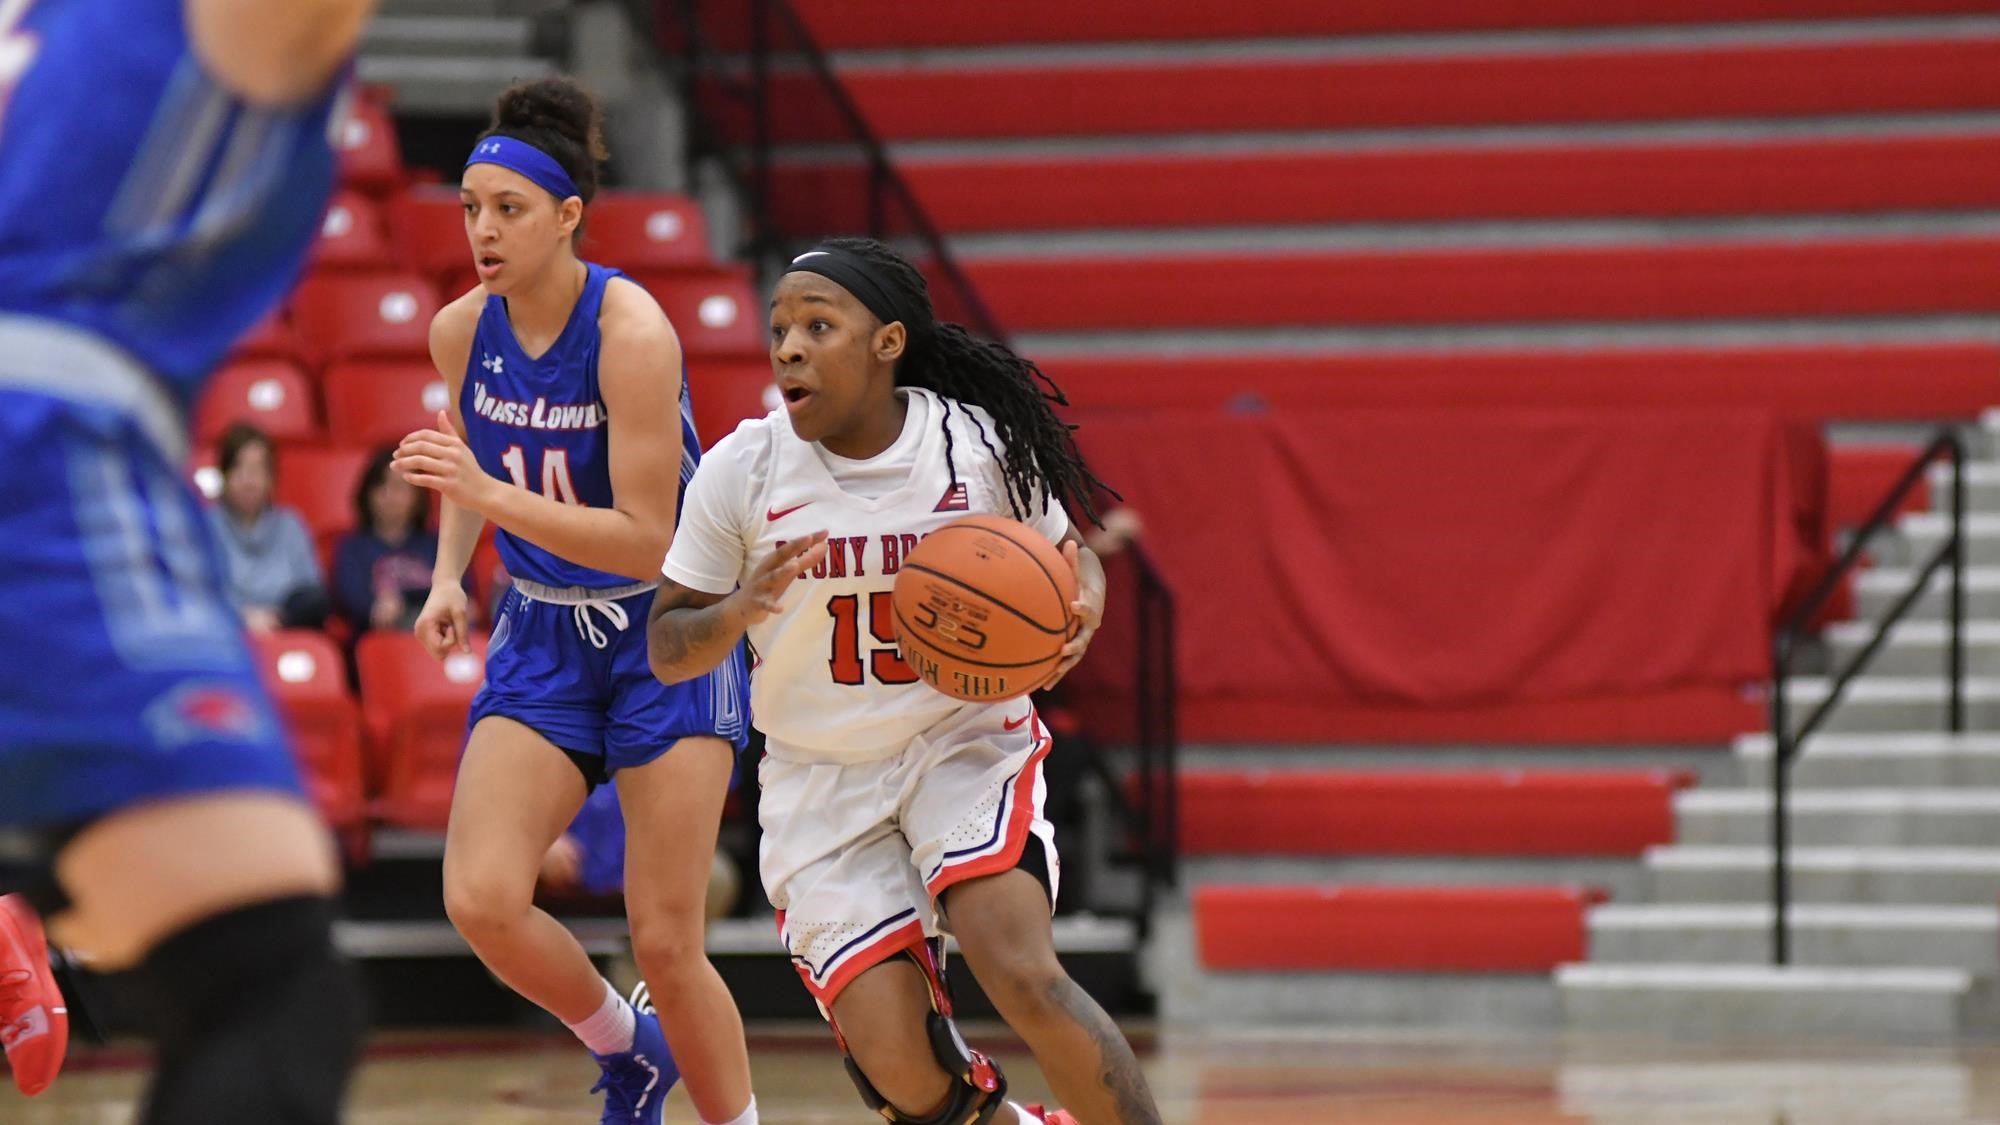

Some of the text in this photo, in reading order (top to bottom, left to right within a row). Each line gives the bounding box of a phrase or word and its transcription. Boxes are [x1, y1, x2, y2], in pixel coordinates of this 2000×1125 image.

[501, 444, 587, 507] 14
[826, 591, 920, 685] 15
[953, 671, 1009, 696] THE
